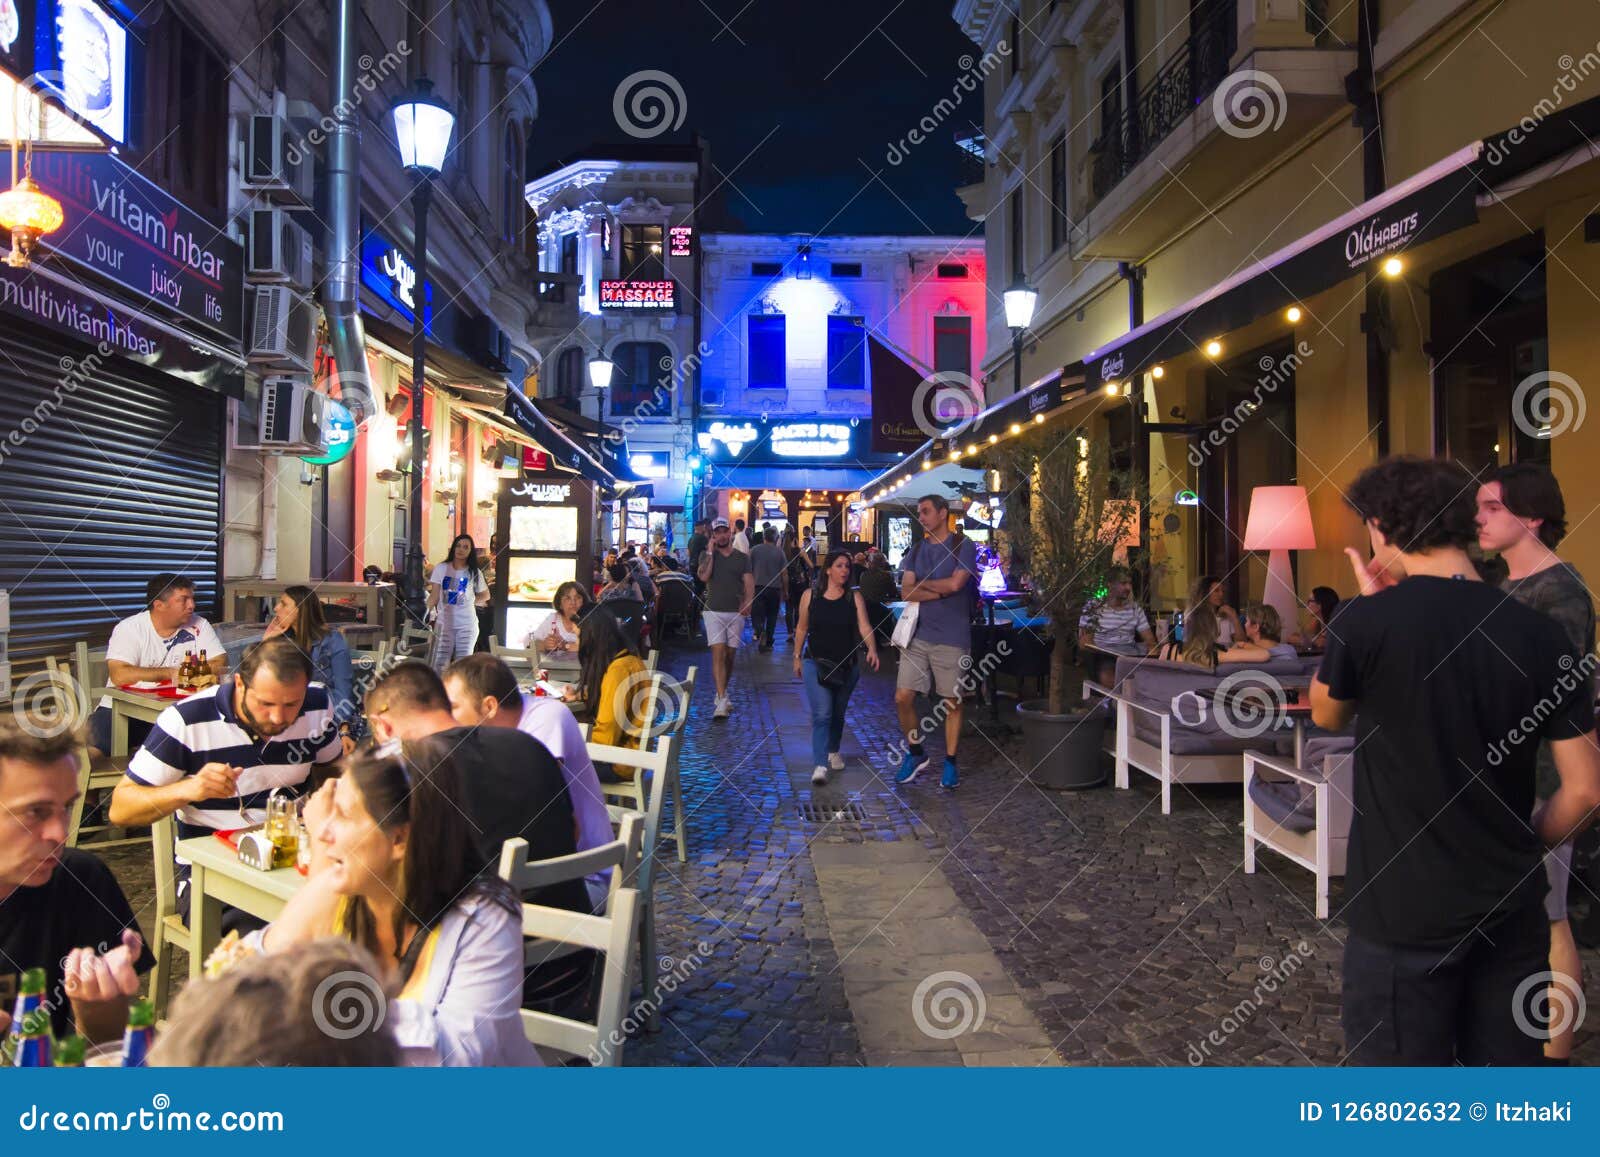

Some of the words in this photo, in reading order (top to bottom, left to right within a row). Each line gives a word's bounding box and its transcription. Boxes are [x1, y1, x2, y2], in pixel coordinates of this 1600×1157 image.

[670, 227, 692, 236] OPEN
[1345, 219, 1376, 261] Old
[1374, 211, 1418, 249] HABITS
[86, 232, 125, 271] your
[150, 263, 183, 307] juicy
[205, 292, 223, 323] life
[602, 281, 628, 289] HOT
[630, 281, 674, 289] TOUCH
[601, 288, 674, 302] MASSAGE
[0, 277, 157, 357] multivitaminbar
